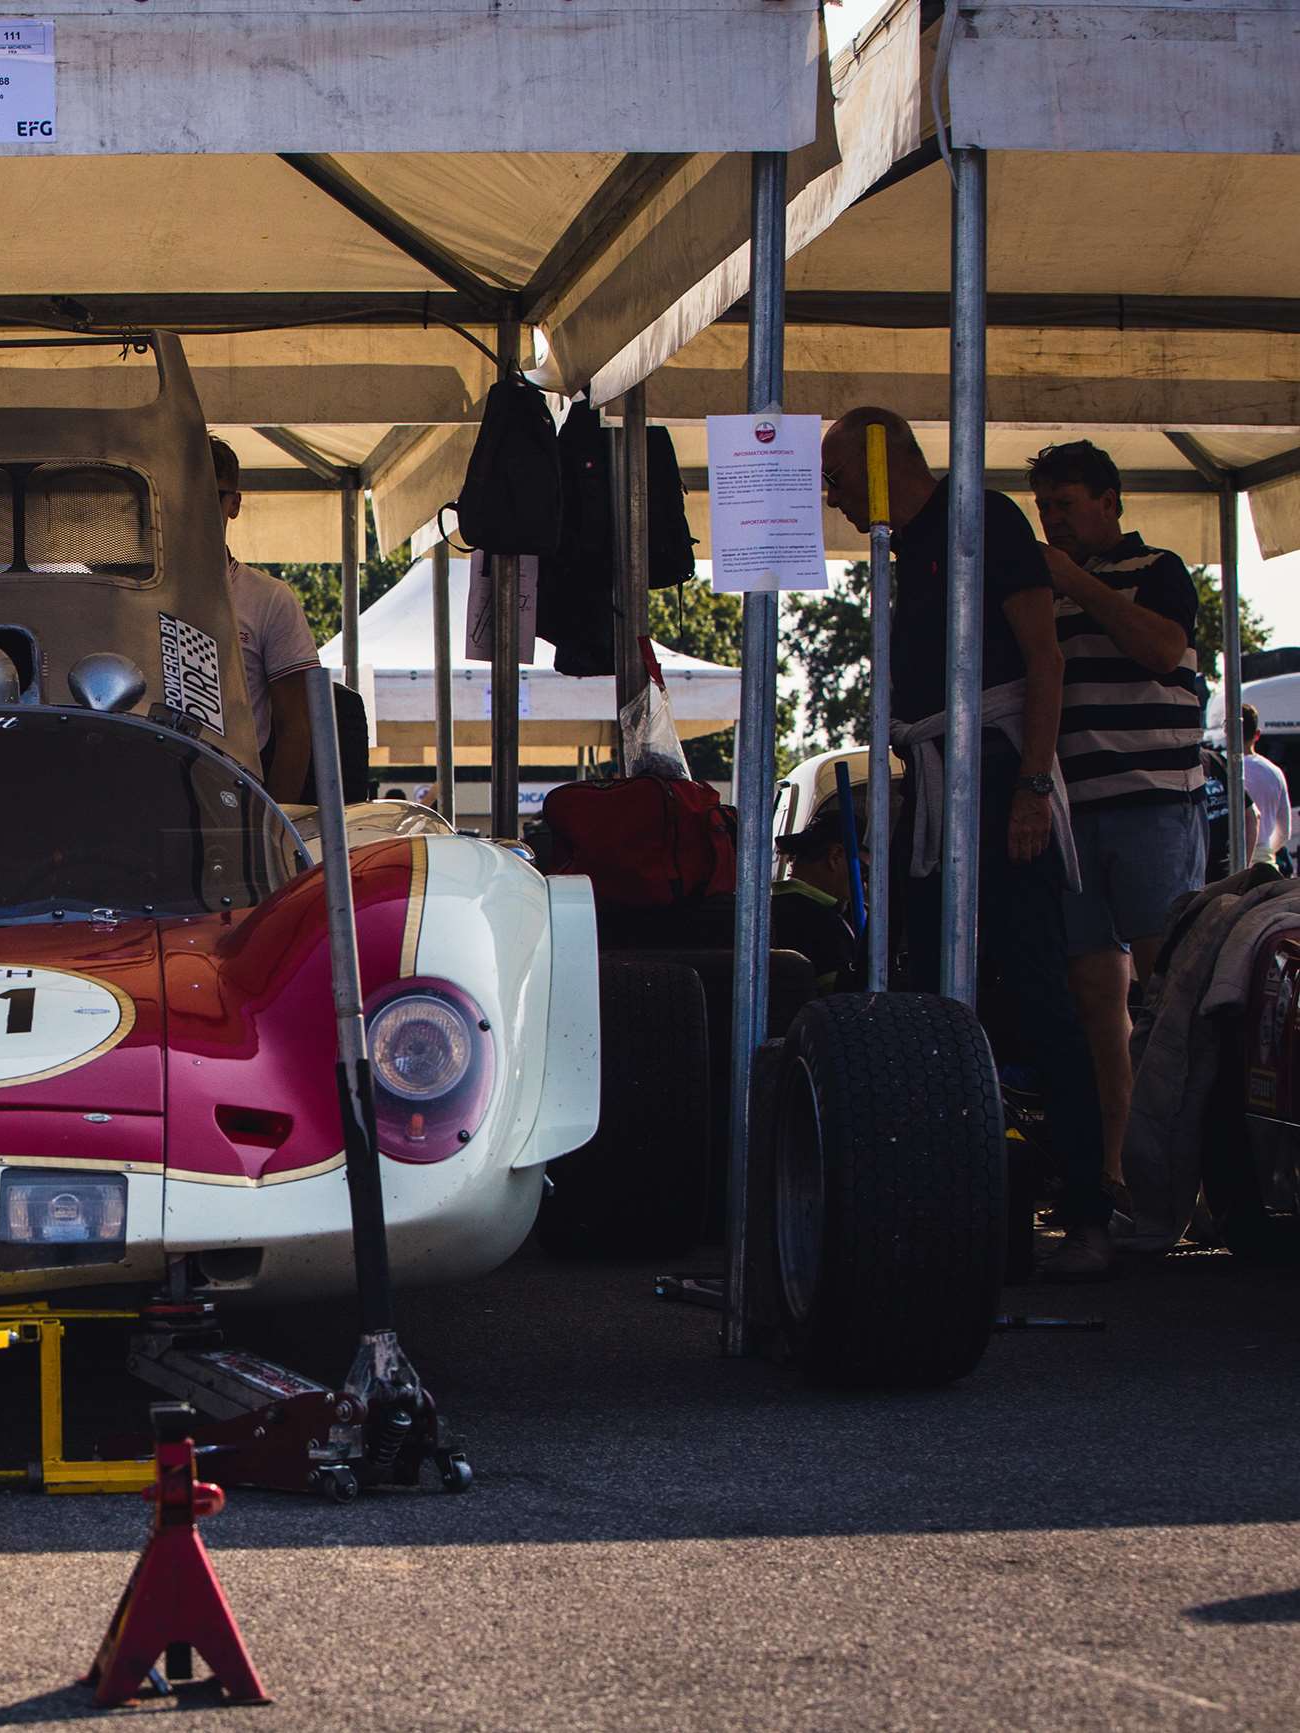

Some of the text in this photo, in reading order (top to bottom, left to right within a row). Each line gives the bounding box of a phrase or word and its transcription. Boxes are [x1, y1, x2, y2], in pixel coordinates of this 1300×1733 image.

[3, 31, 21, 40] 111
[17, 120, 53, 137] EFG
[159, 613, 182, 712] POWERED BY
[181, 655, 222, 734] PURE
[518, 793, 545, 803] DICA
